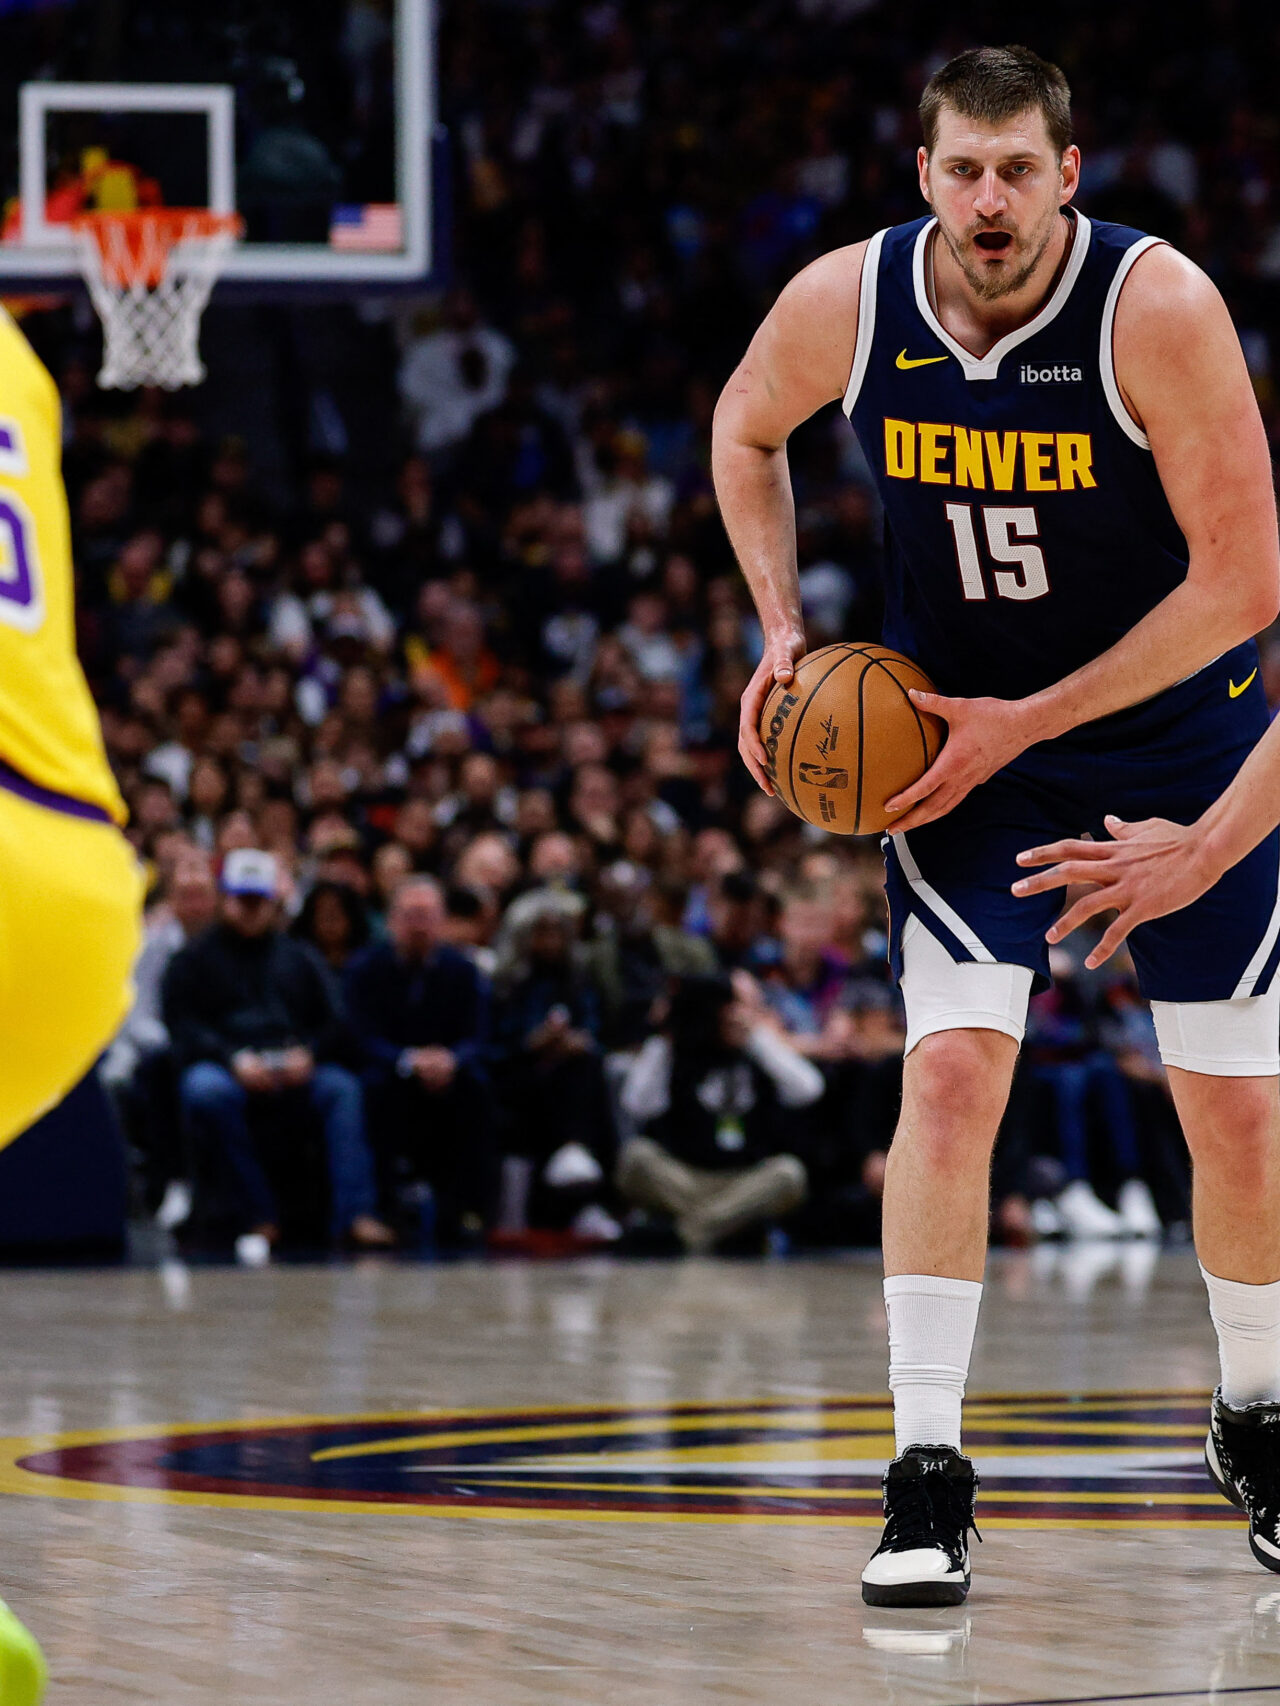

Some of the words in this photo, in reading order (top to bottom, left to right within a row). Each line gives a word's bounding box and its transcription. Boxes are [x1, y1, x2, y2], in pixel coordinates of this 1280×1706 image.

[1020, 364, 1083, 384] ibotta
[884, 417, 1098, 492] DENVER
[944, 501, 1050, 601] 15
